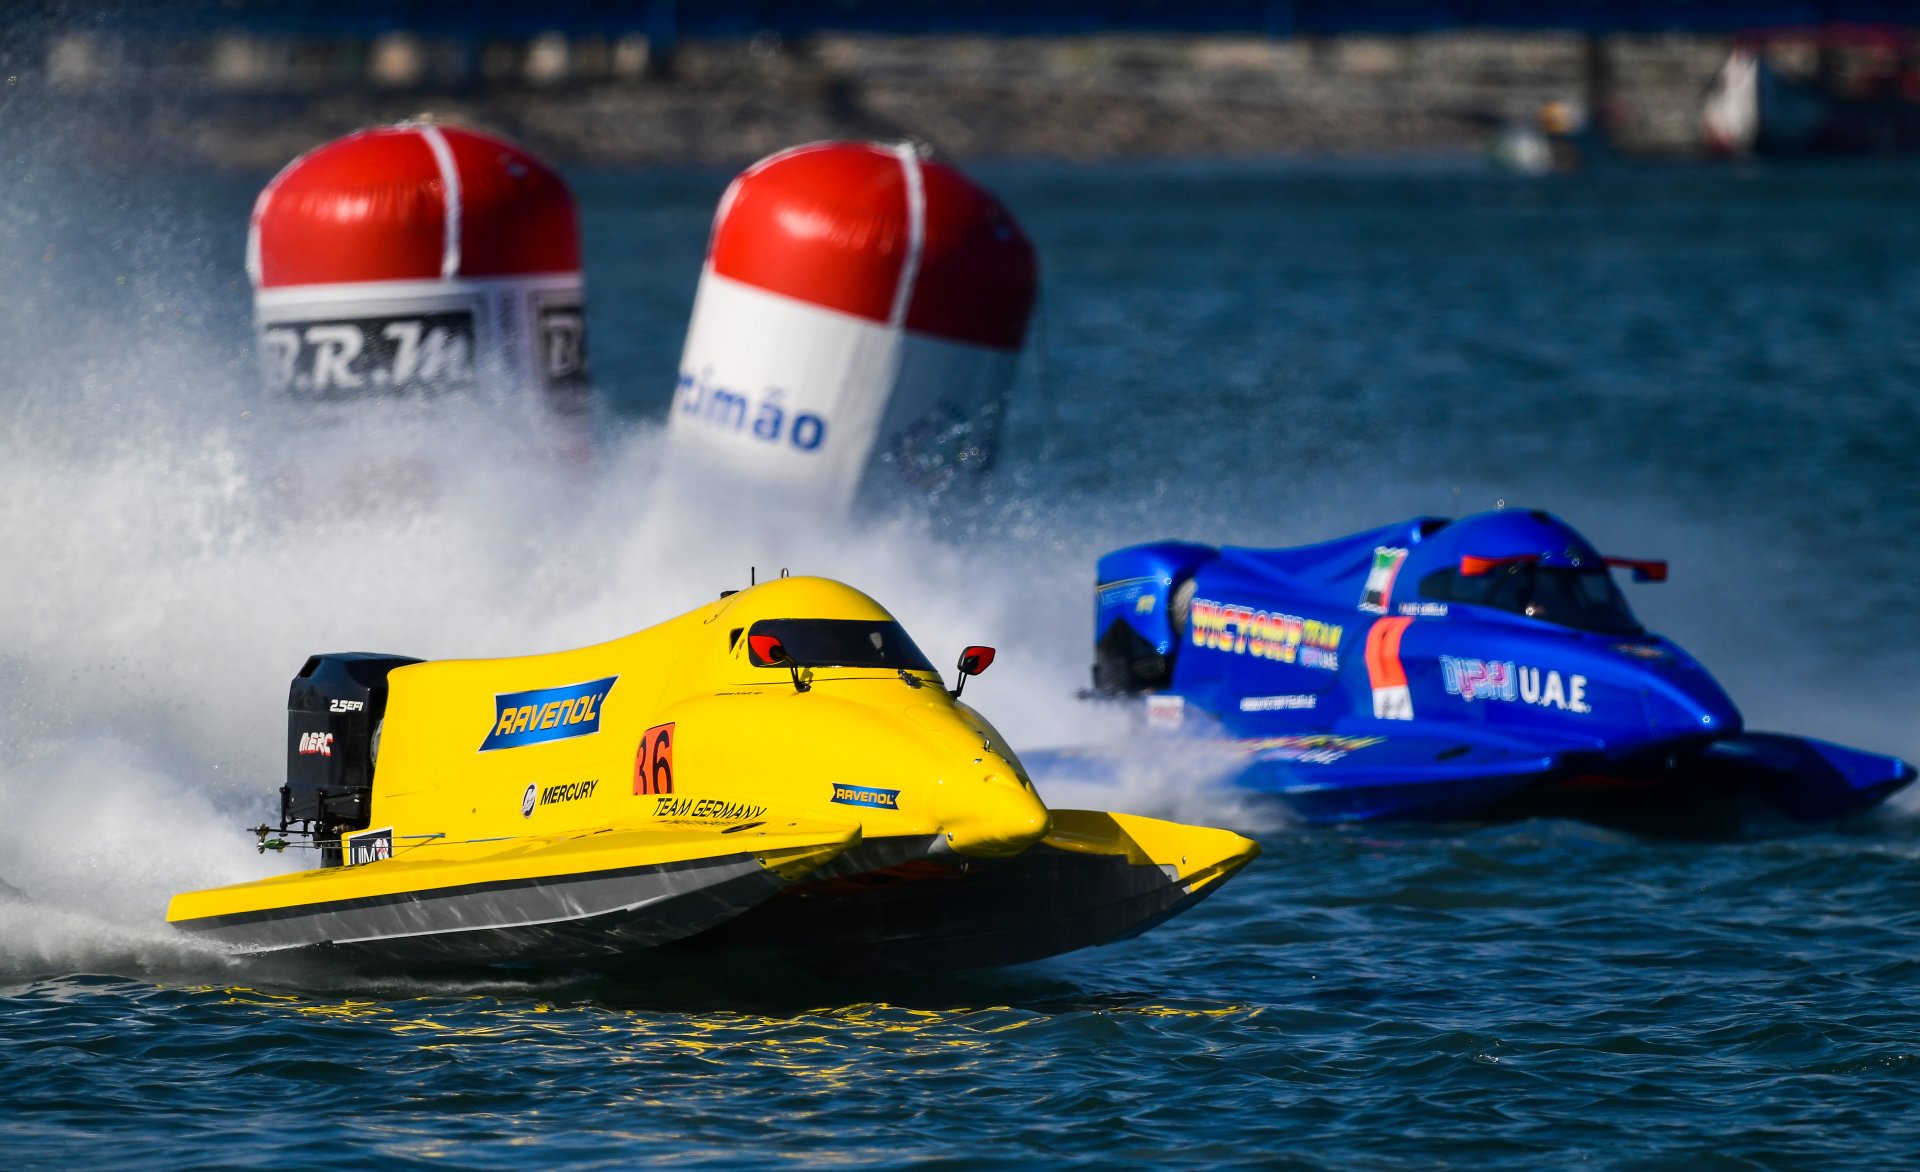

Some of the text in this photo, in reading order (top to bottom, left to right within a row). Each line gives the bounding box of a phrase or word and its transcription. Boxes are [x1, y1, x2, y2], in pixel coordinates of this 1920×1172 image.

[1191, 598, 1304, 664] VICTORY
[495, 693, 597, 736] RAVENOL
[299, 731, 334, 756] MERC
[635, 730, 673, 796] 36
[540, 779, 599, 805] MERCURY
[836, 788, 894, 805] RAVENOL
[653, 798, 768, 820] TEAM GERMANY
